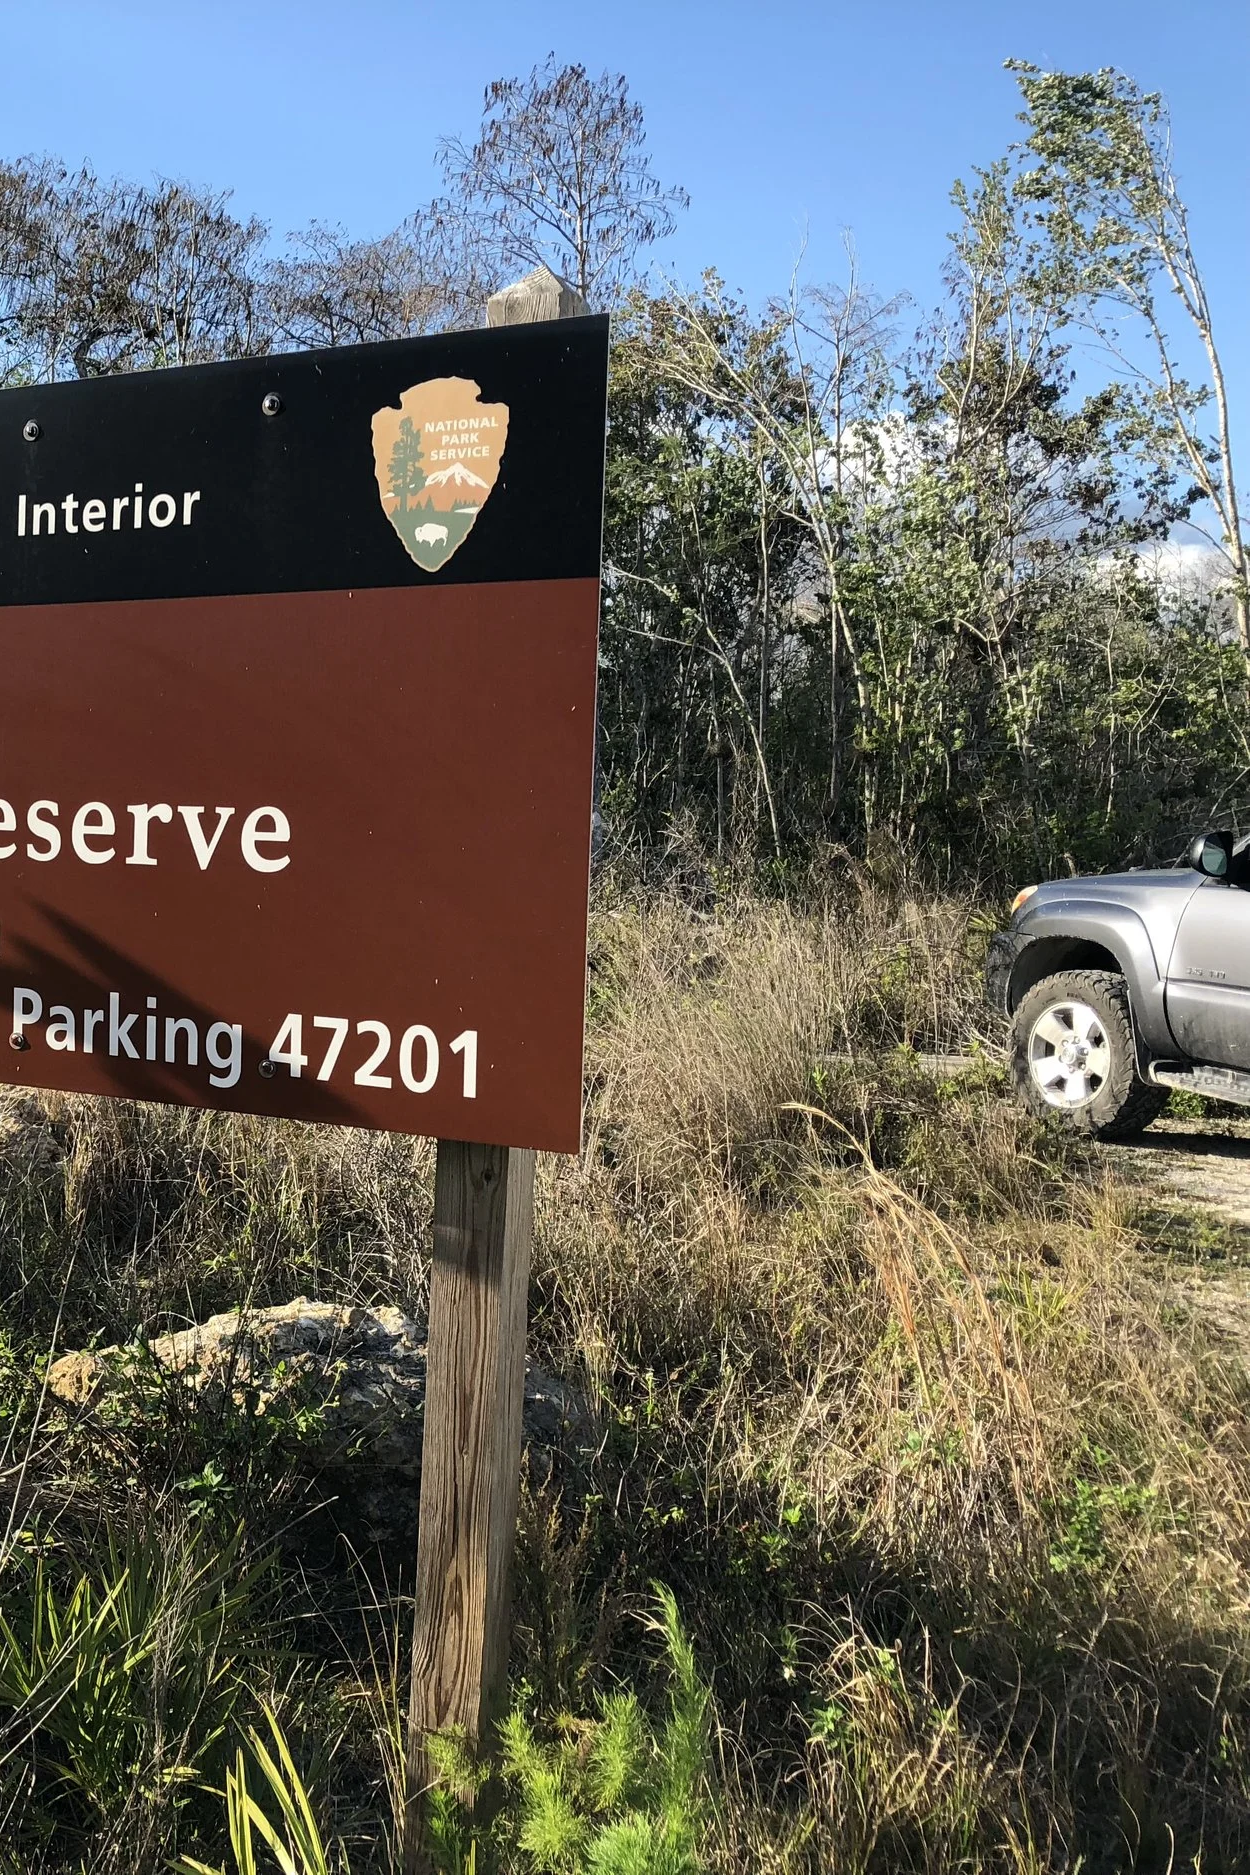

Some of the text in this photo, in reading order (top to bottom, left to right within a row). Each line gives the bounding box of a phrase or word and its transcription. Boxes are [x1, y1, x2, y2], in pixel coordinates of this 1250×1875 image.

[425, 417, 498, 433] NATIONAL
[442, 432, 479, 446] PARK
[430, 446, 490, 461] SERVICE
[18, 483, 200, 536] Interior
[12, 987, 243, 1089] Parking
[269, 1013, 477, 1098] 47201
